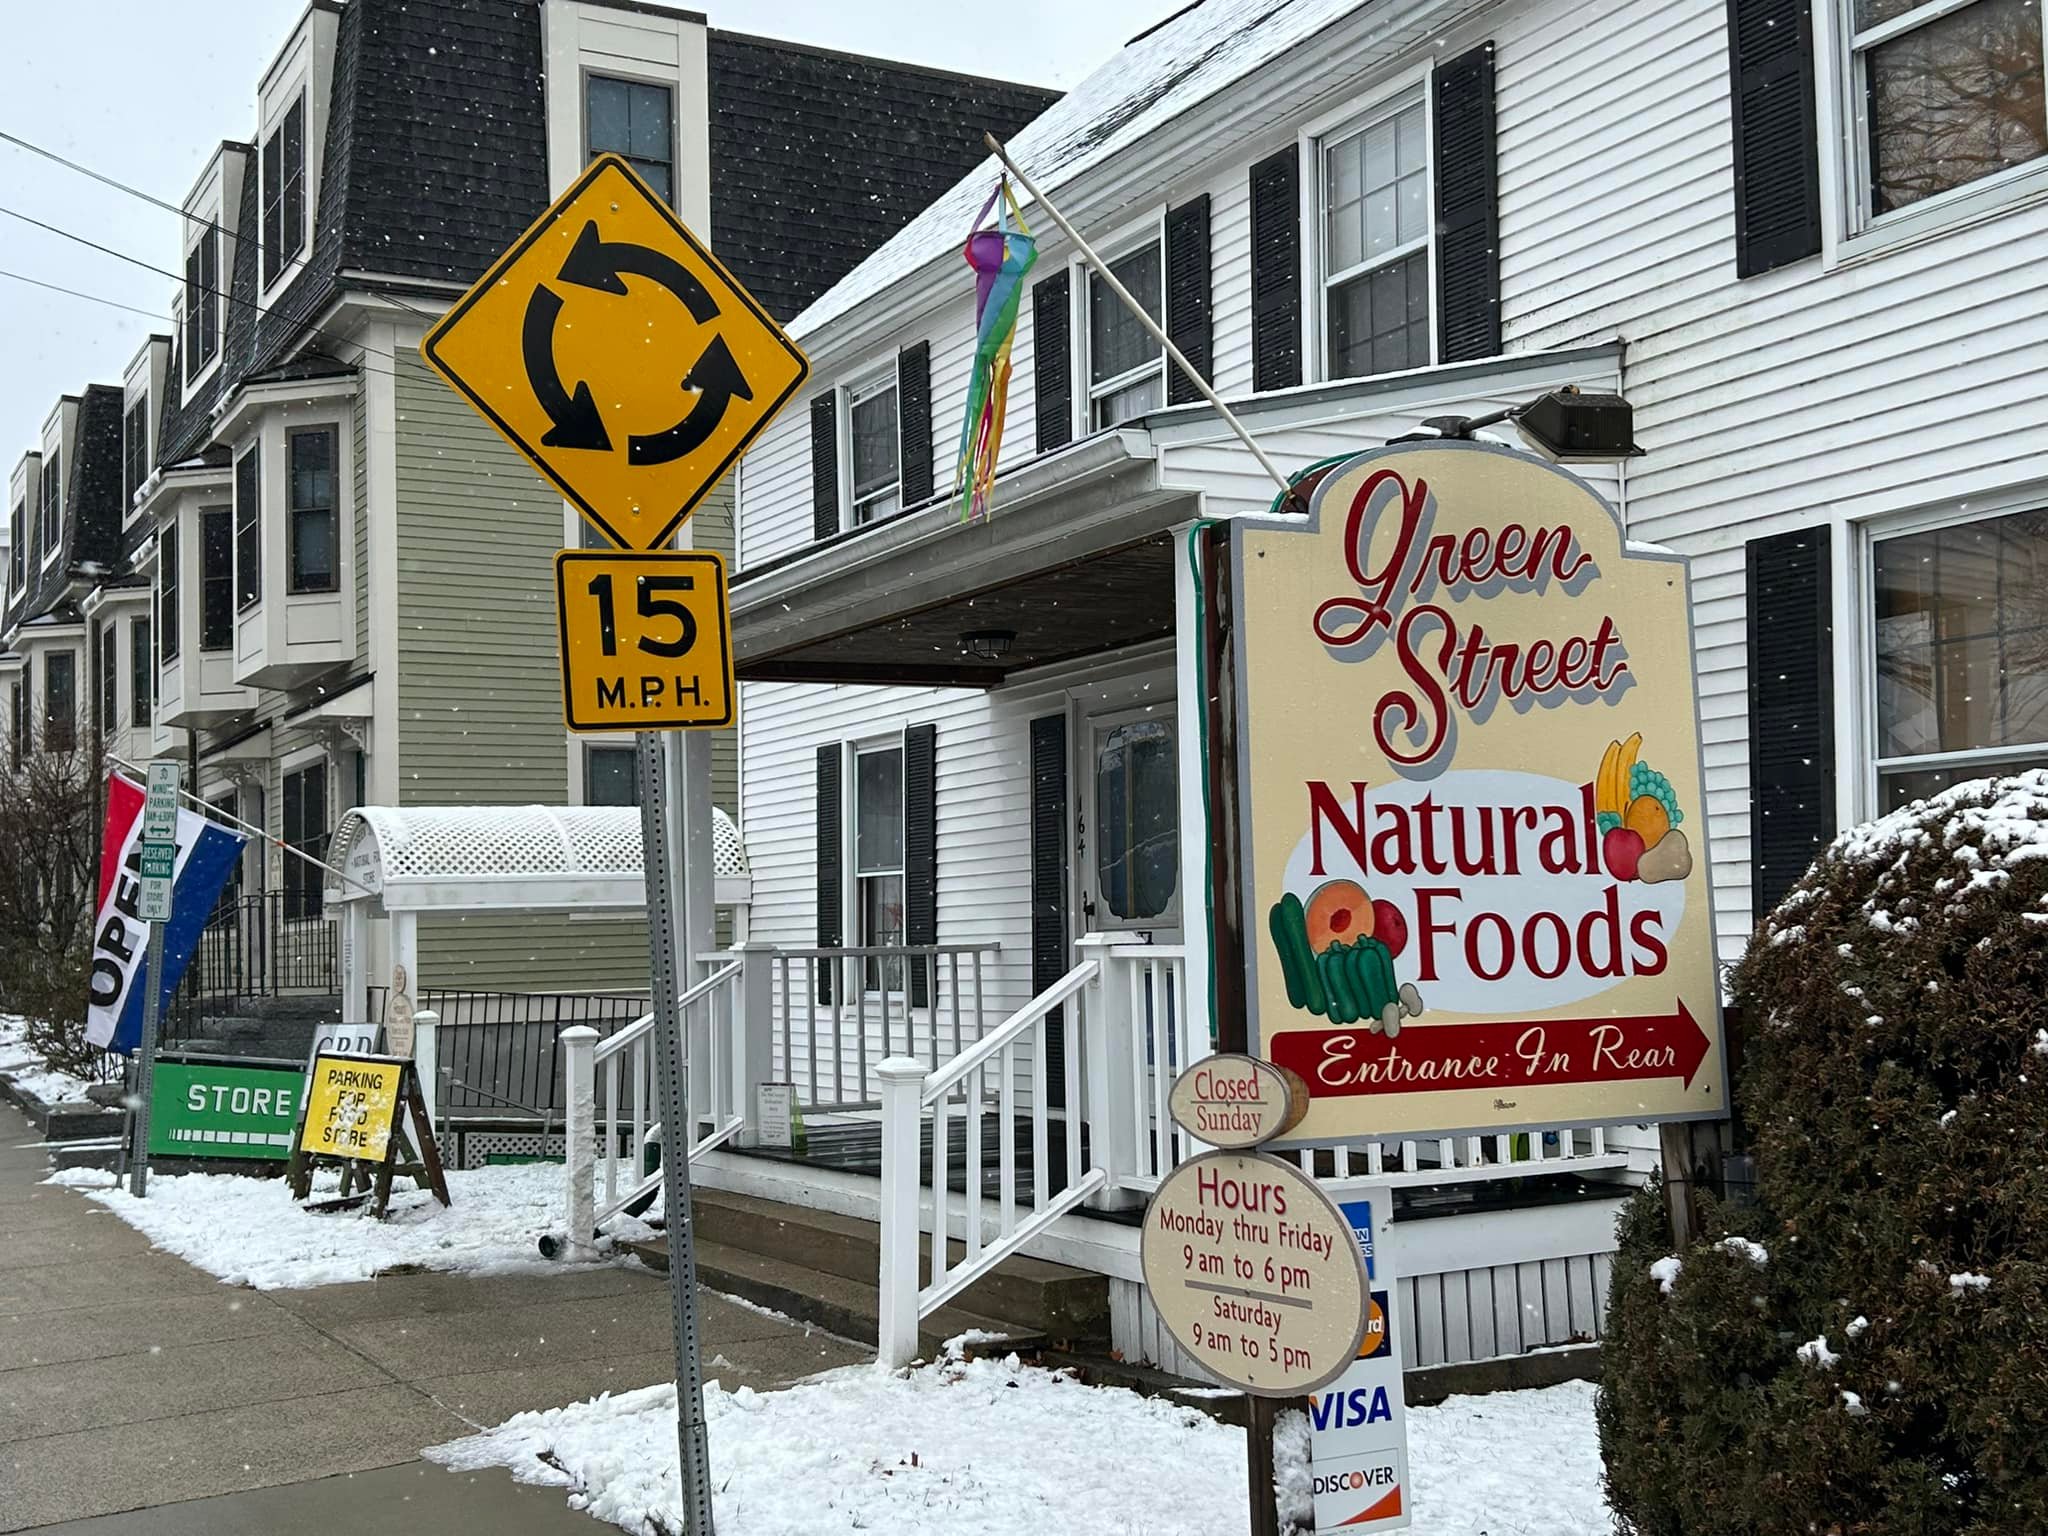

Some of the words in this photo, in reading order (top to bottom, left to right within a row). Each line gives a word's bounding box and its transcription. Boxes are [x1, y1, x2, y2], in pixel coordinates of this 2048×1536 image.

[1312, 468, 1593, 646] Green
[588, 574, 698, 658] 15
[596, 675, 710, 709] M.P.H.
[1372, 604, 1628, 766] Street
[149, 797, 175, 809] PARKING
[1306, 780, 1602, 878] Natural
[142, 846, 173, 861] RESERVED
[144, 862, 171, 876] PARKING
[1414, 884, 1667, 982] Foods
[1317, 1034, 1499, 1086] Entrance
[1516, 1026, 1571, 1077] In
[1590, 1023, 1677, 1070] Rear
[328, 1069, 383, 1089] PARKING
[1195, 1064, 1260, 1100] Closed
[187, 1084, 292, 1116] STORE
[338, 1090, 366, 1107] FOR
[1196, 1105, 1261, 1137] Sunday
[1197, 1167, 1287, 1215] Hours
[1160, 1208, 1224, 1244] Monday
[1233, 1215, 1269, 1244] thru
[1278, 1221, 1333, 1261] Friday
[1233, 1255, 1254, 1280] to
[1213, 1296, 1282, 1336] Saturday
[1240, 1335, 1259, 1358] to
[1309, 1385, 1392, 1432] VISA
[1313, 1466, 1394, 1495] DISCOVER
